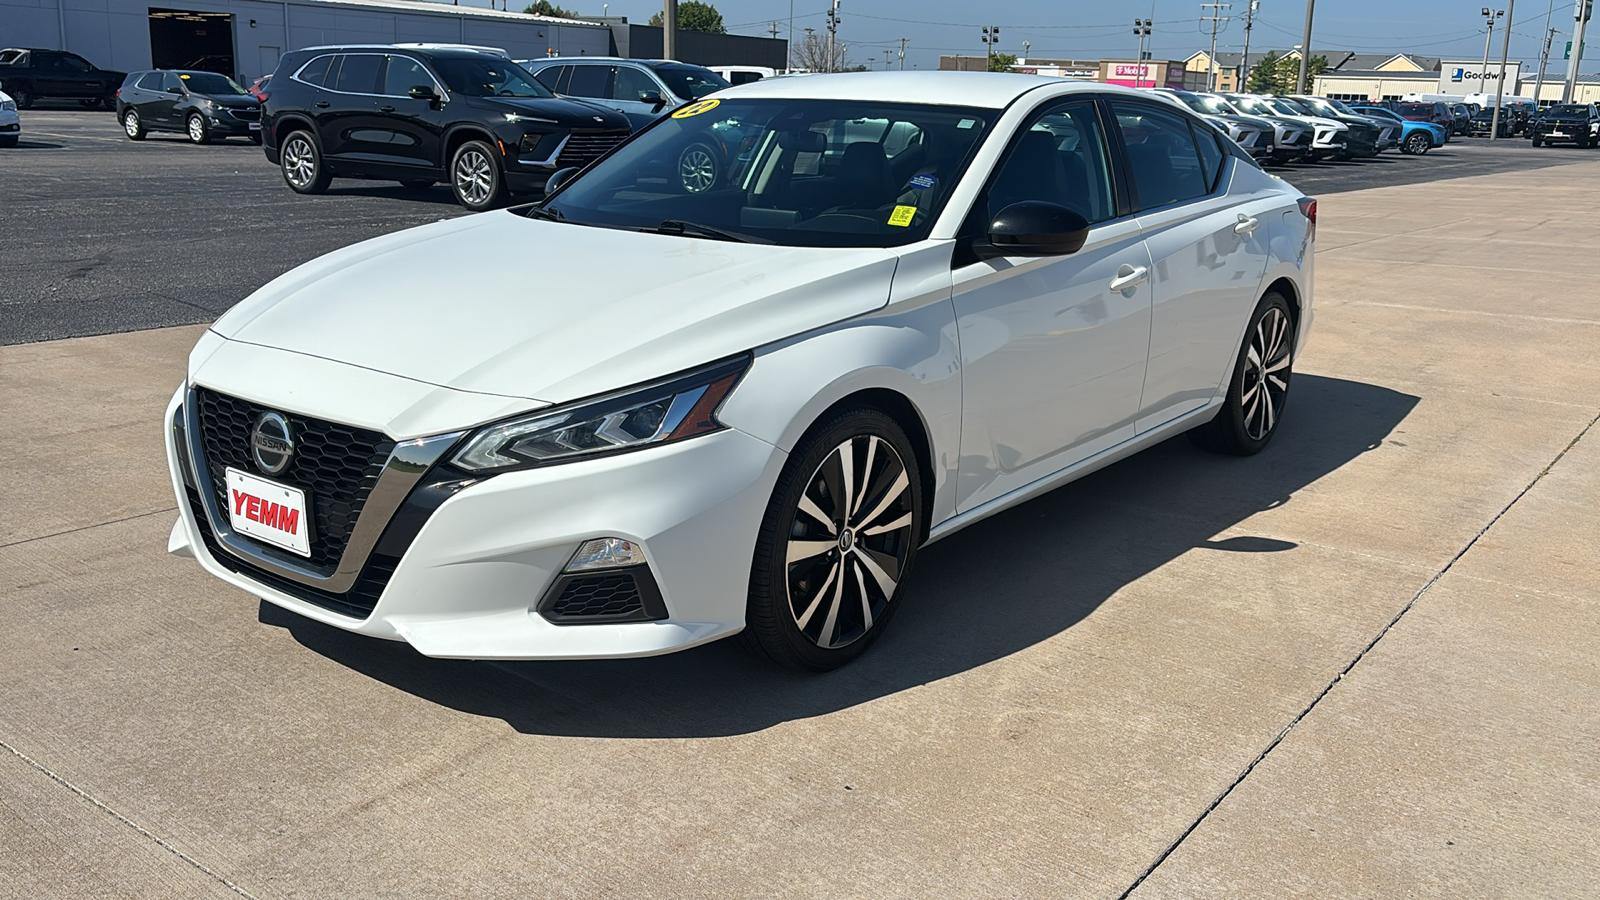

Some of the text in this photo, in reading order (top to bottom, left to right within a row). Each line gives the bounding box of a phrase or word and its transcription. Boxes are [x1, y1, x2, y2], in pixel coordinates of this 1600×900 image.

[1124, 66, 1146, 75] Moble
[1464, 71, 1506, 80] Goodwl
[254, 434, 287, 451] NISSAN
[232, 488, 299, 535] YEMM
